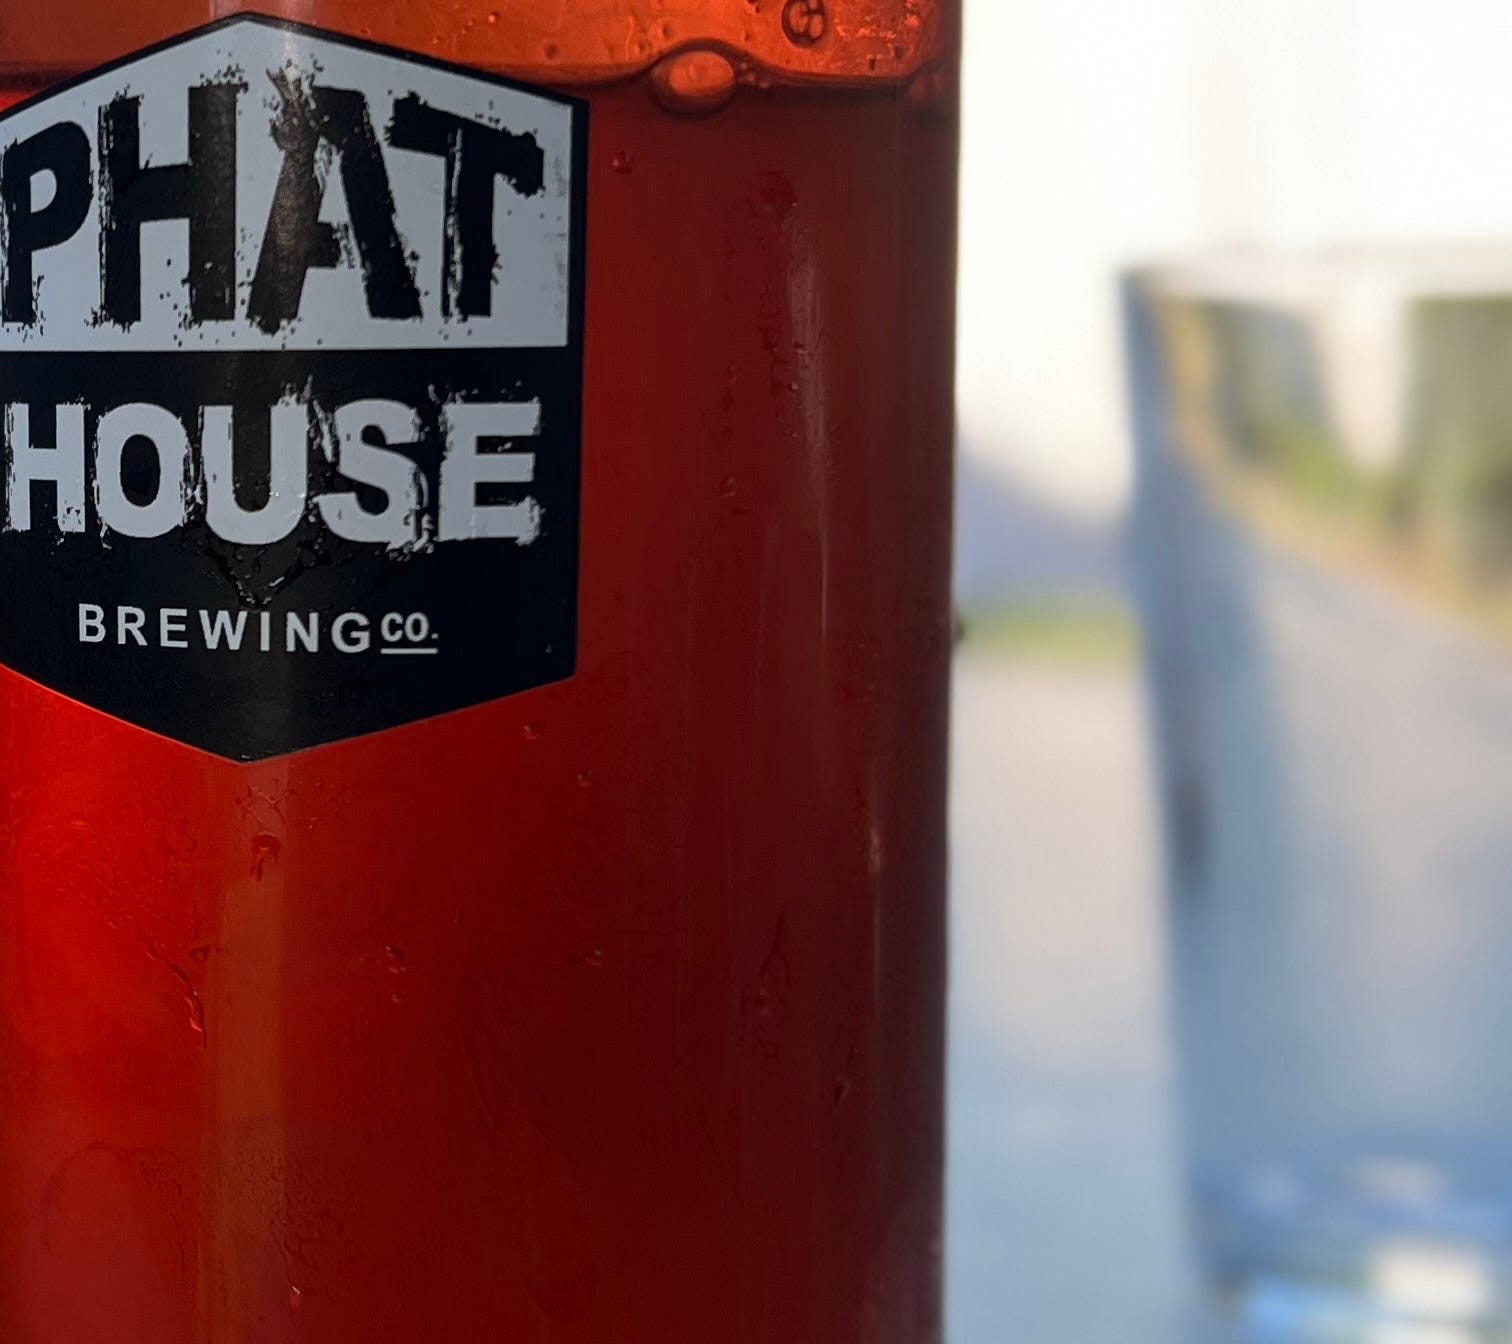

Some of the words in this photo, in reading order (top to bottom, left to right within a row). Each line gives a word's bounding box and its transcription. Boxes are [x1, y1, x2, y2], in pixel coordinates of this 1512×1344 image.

[4, 391, 542, 549] HOUSE
[78, 603, 371, 653] BREWING
[380, 613, 439, 643] CO.
